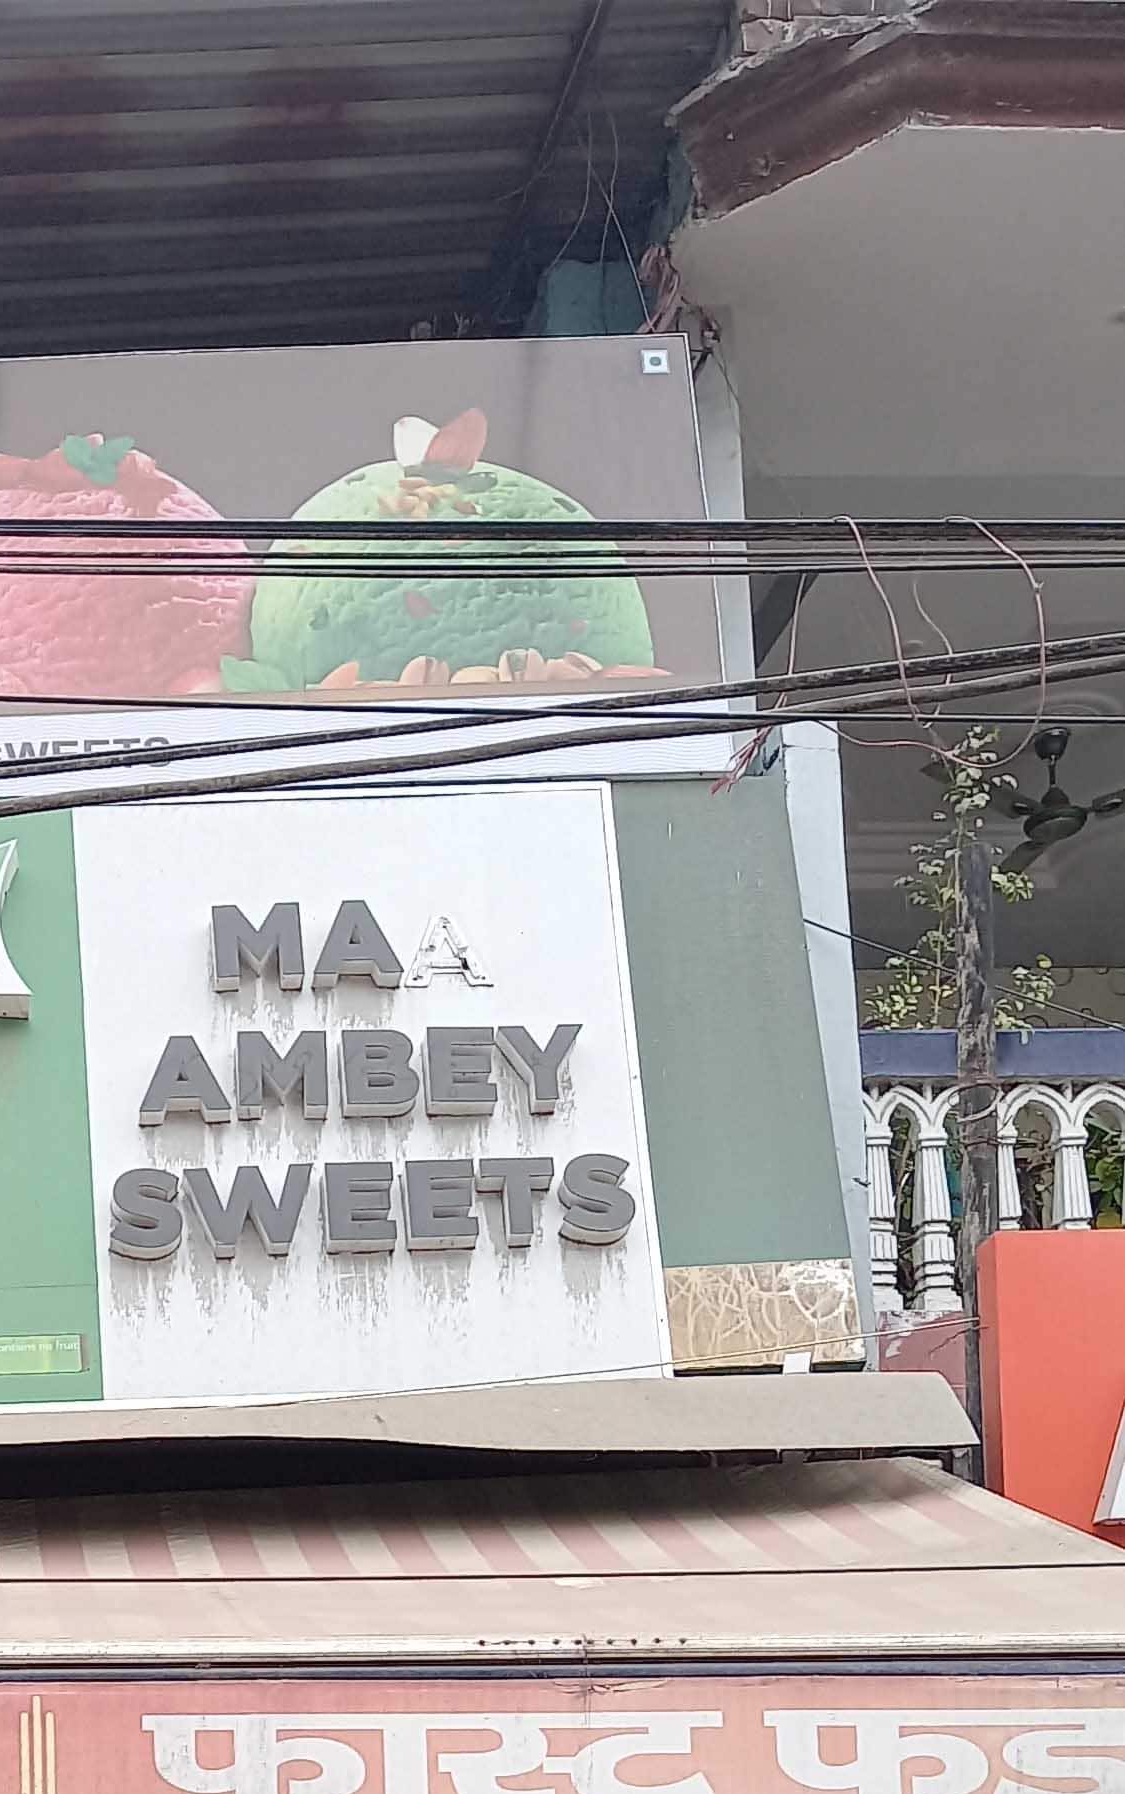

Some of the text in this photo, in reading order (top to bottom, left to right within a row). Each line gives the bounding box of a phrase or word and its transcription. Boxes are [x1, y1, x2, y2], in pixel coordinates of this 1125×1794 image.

[210, 899, 495, 992] MAA
[138, 1023, 584, 1127] AMBEY
[108, 1153, 637, 1261] SWEETS
